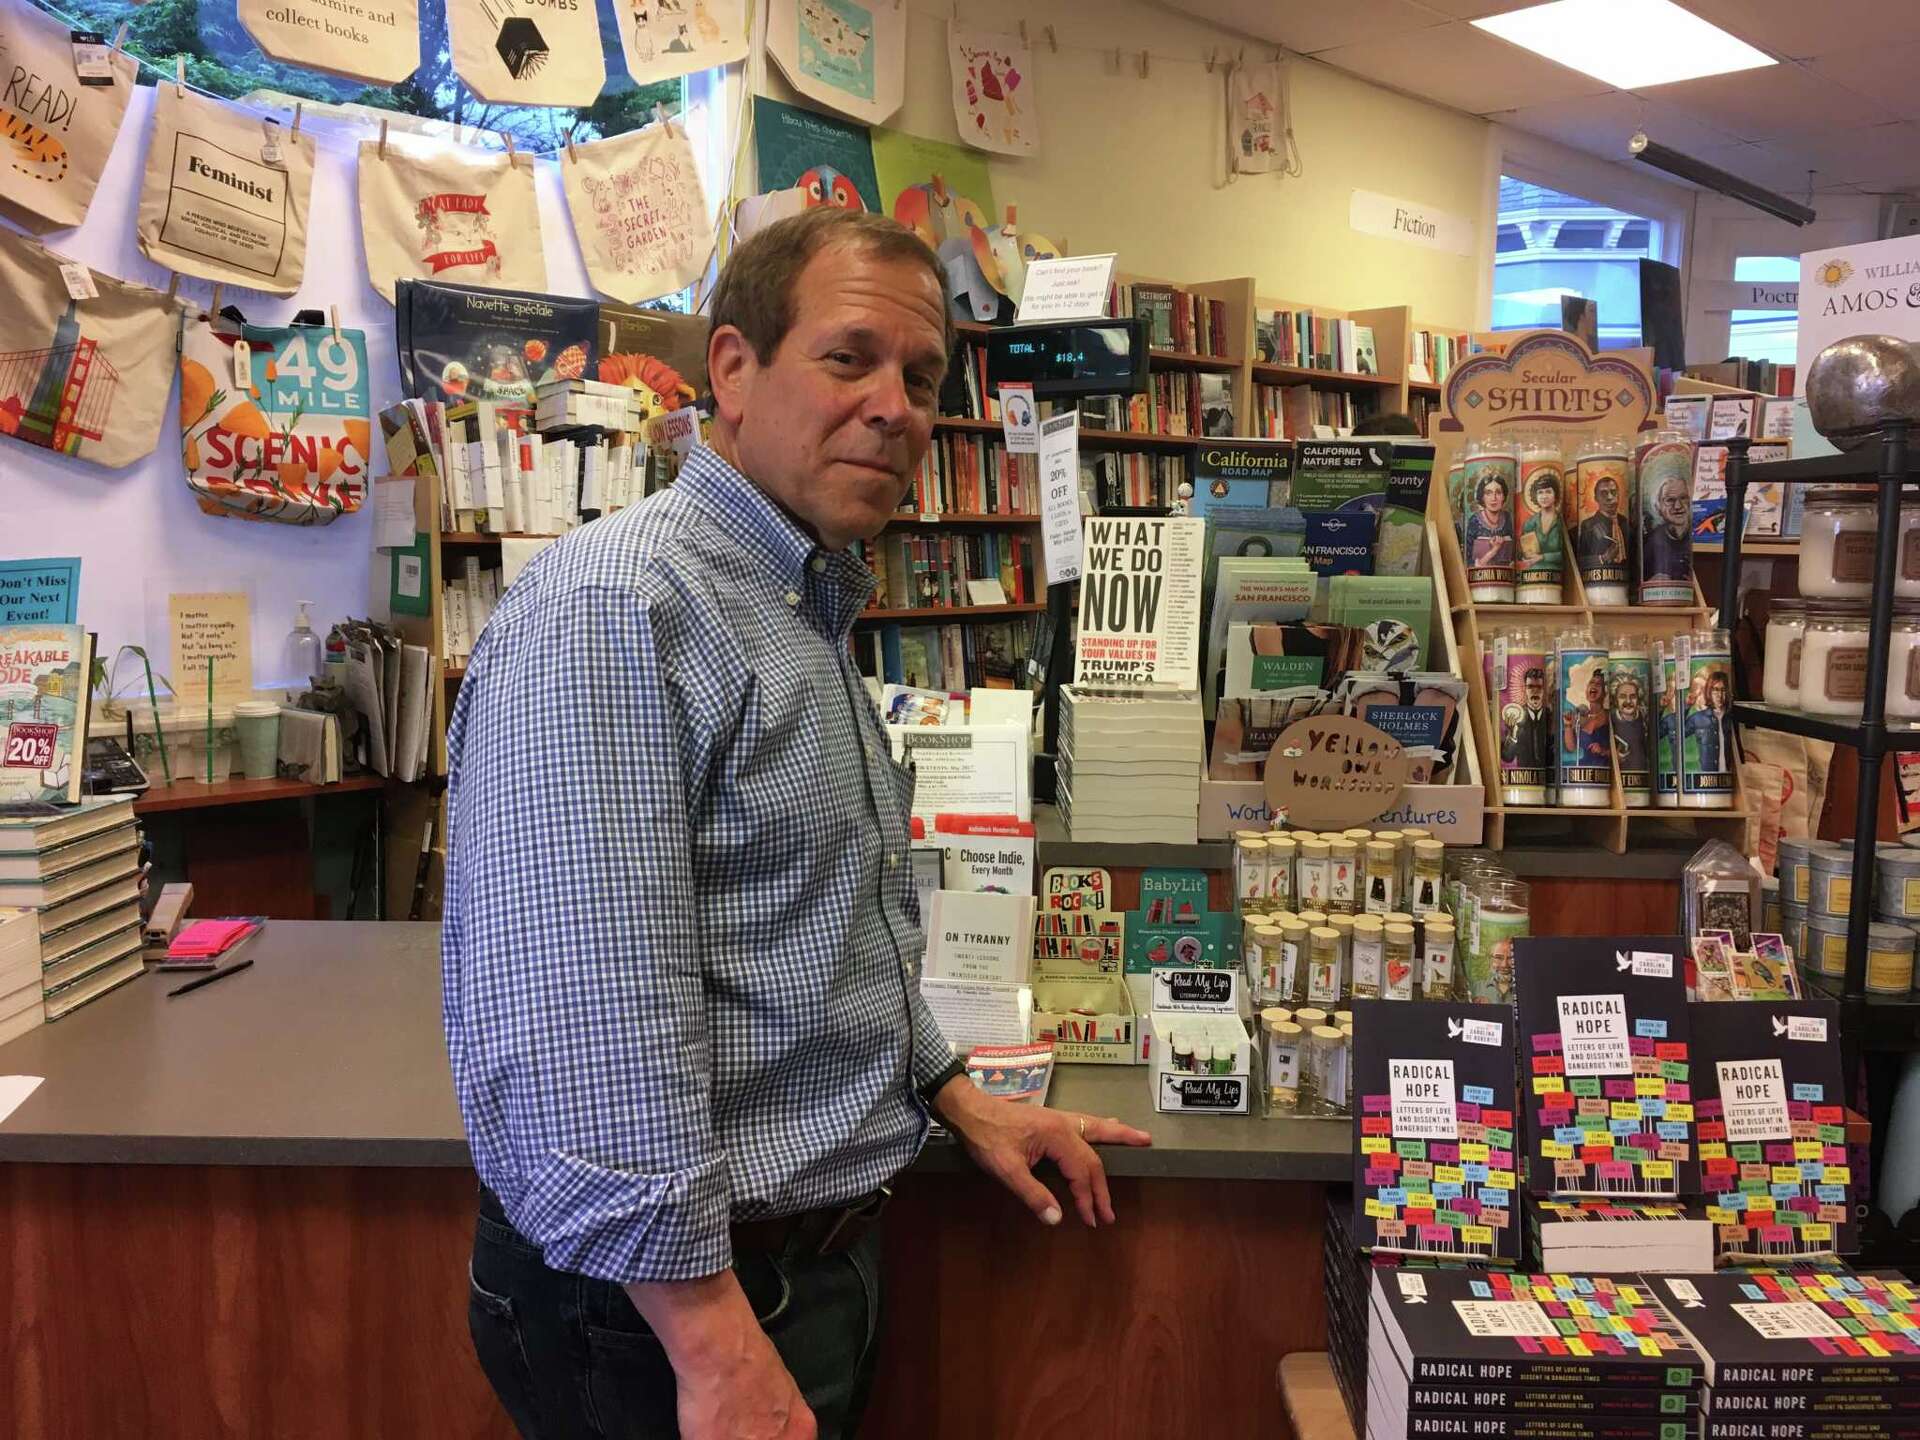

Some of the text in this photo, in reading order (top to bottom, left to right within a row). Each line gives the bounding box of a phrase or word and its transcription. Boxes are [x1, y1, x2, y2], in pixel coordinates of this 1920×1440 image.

[266, 8, 369, 44] collect books
[368, 11, 395, 26] and
[4, 65, 77, 131] READ!
[188, 155, 274, 203] Feminist
[628, 196, 650, 212] THE
[623, 211, 661, 234] SECRET
[1393, 207, 1437, 239] Fiction
[626, 231, 668, 250] GARDEN
[443, 253, 462, 265] FOR
[466, 296, 510, 314] Navette
[1822, 287, 1898, 317] AMOS
[1008, 342, 1035, 354] TOTAL
[275, 334, 359, 391] 49
[1522, 370, 1577, 384] Secular
[278, 388, 361, 409] MILE
[1487, 385, 1613, 413] SAINTS
[1303, 447, 1361, 456] CALIFORNIA
[1207, 451, 1288, 468] California
[1302, 457, 1363, 466] NATURE SET
[1050, 467, 1067, 482] 20%
[1221, 467, 1273, 476] ROAD MAP
[1051, 485, 1068, 500] OFF
[1091, 522, 1165, 546] WHAT
[1315, 546, 1367, 556] FRANCISCO
[1089, 547, 1163, 572] WE DO
[1314, 556, 1334, 566] Map
[36, 575, 67, 588] Miss
[1239, 585, 1252, 593] THE
[0, 593, 60, 606] Our Next
[1082, 573, 1163, 633] NOW
[1234, 594, 1311, 603] SAN FRANCISCO
[6, 609, 49, 622] Event!
[1081, 638, 1157, 649] STANDING UP FOR
[0, 649, 70, 669] EAKABLE
[1081, 649, 1157, 661] YOUR VALUES IN
[1080, 660, 1155, 673] TRUMP'S
[1263, 661, 1313, 671] WALDEN
[1079, 672, 1154, 686] AMERICA
[1371, 711, 1440, 721] SHERLOCK
[1378, 722, 1430, 731] HOLMES
[7, 737, 50, 762] 20%
[1308, 729, 1401, 759] YELLOW
[33, 754, 50, 766] OFF
[1341, 759, 1383, 775] OWL
[1371, 803, 1458, 825] entures
[960, 849, 1026, 866] Choose Indie,
[971, 864, 1014, 876] Every Month
[1050, 871, 1103, 894] BOOKS
[1144, 877, 1202, 893] BabyLit
[1050, 892, 1104, 911] ROCK!
[945, 931, 1011, 946] ON TYRANNY
[1173, 974, 1230, 993] Read My Lips
[1562, 1001, 1622, 1016] RADICAL
[1576, 1019, 1612, 1034] HOPE
[1063, 1043, 1105, 1051] BUTTONS
[1567, 1043, 1596, 1051] LETTERS
[1608, 1042, 1624, 1050] LOVE
[1586, 1052, 1614, 1060] DISSENT
[1393, 1064, 1450, 1081] RADICAL
[1567, 1061, 1629, 1070] DANGEROUS TIMES
[1721, 1064, 1780, 1082] RADICAL
[1184, 1082, 1239, 1100] Read My Lips
[1406, 1083, 1440, 1098] HOPE
[1735, 1084, 1770, 1099] HOPE
[1396, 1106, 1424, 1114] LETTERS
[1435, 1107, 1451, 1115] LOVE
[1413, 1116, 1442, 1124] DISSENT
[1434, 1125, 1455, 1133] TIMES
[1421, 1363, 1512, 1379] RADICAL HOPE
[1723, 1368, 1776, 1382] RADICAL
[1782, 1368, 1814, 1382] HOPE
[1415, 1391, 1468, 1405] RADICAL
[1474, 1392, 1506, 1406] HOPE
[1715, 1396, 1768, 1409] RADICAL
[1774, 1396, 1806, 1409] HOPE
[1415, 1419, 1468, 1433] RADICAL
[1474, 1420, 1506, 1434] HOPE
[1712, 1424, 1765, 1437] RADICAL
[1771, 1424, 1804, 1437] HOPE
